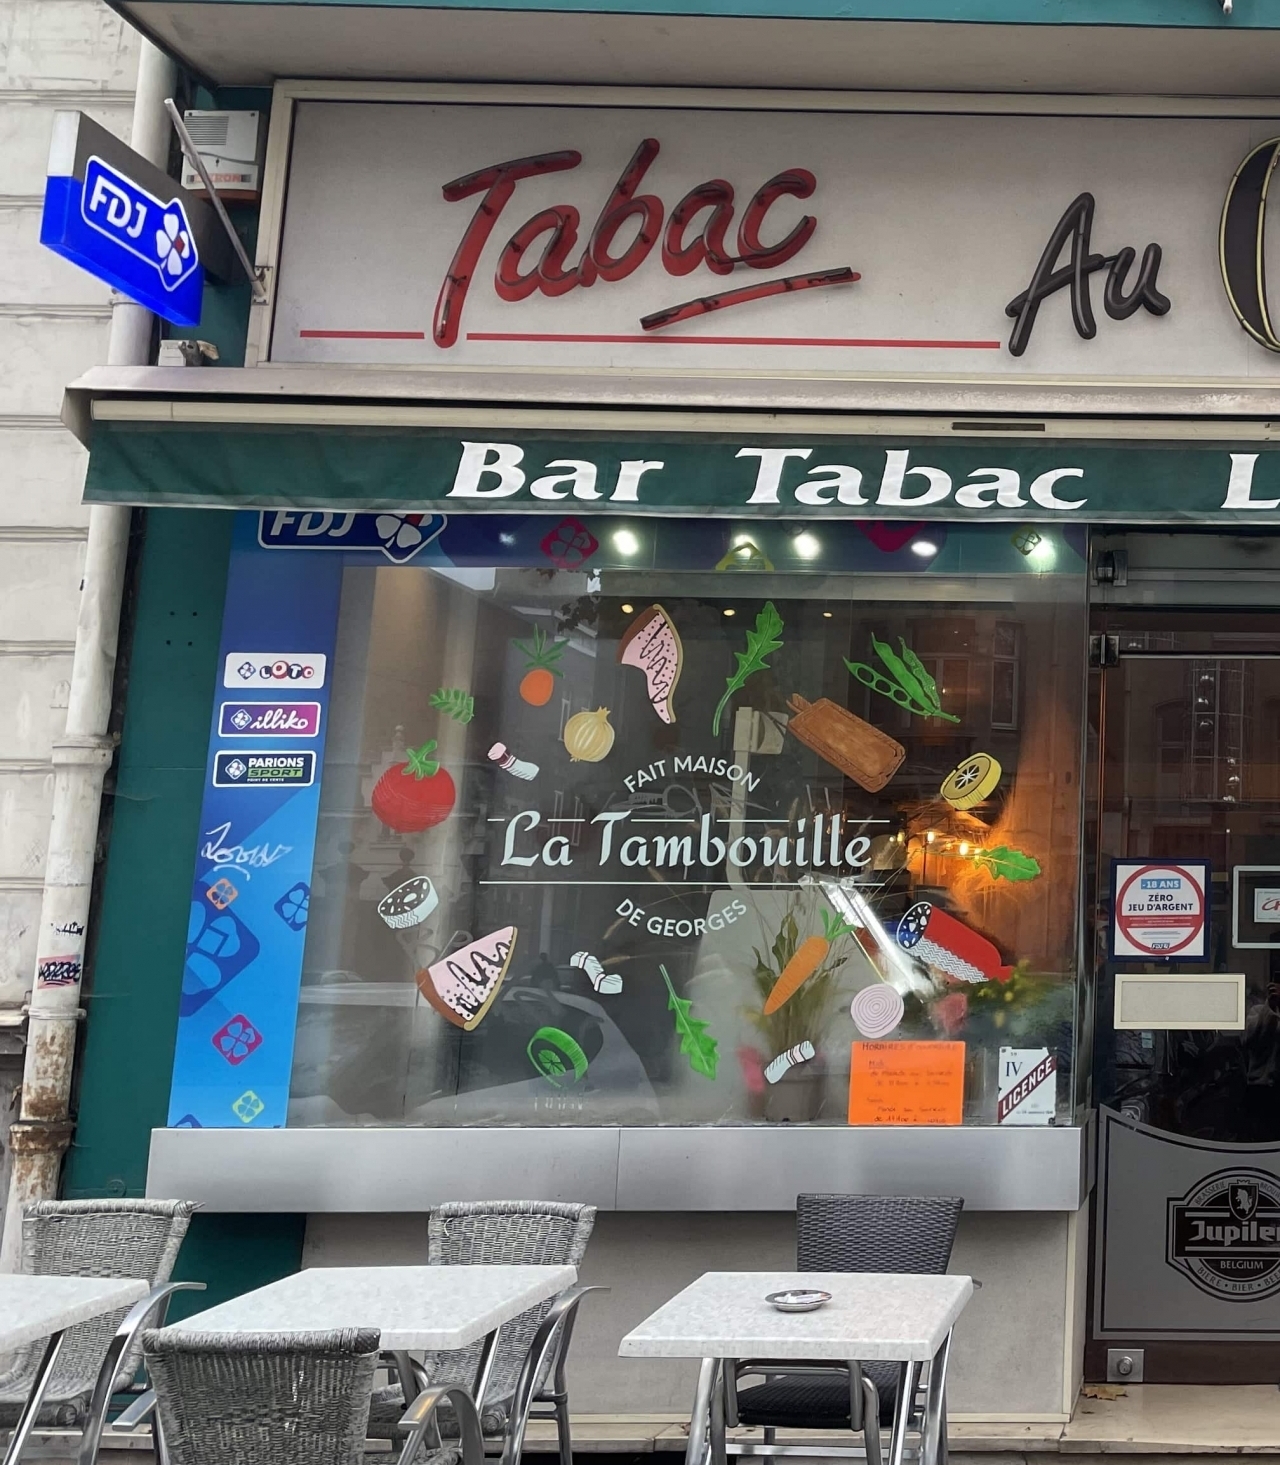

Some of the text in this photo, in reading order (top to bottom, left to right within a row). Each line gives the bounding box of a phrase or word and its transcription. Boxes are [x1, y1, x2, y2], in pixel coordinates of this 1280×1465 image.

[89, 174, 148, 238] FDJ
[443, 138, 817, 349] Tabac
[1005, 192, 1171, 357] Au
[446, 441, 664, 502] Bar
[735, 448, 1087, 511] Tabac
[269, 510, 356, 538] FDJ
[259, 660, 315, 679] LOTO
[250, 707, 309, 730] illiko
[248, 757, 305, 768] PARIONS
[250, 769, 302, 777] SPORT
[623, 755, 761, 793] FAIT MAISON
[501, 809, 872, 868] La Tambouille
[1159, 880, 1180, 889] ANS
[1128, 902, 1194, 912] JEU D'ARGENT
[1148, 892, 1174, 902] ZÉRO
[615, 898, 748, 938] DE GEORGES
[1005, 1061, 1023, 1077] IV
[1002, 1056, 1053, 1116] LICENCE
[1194, 1181, 1226, 1205] BRASSERIE
[1220, 1260, 1264, 1269] BELGIUM
[1231, 1283, 1255, 1292] BIER
